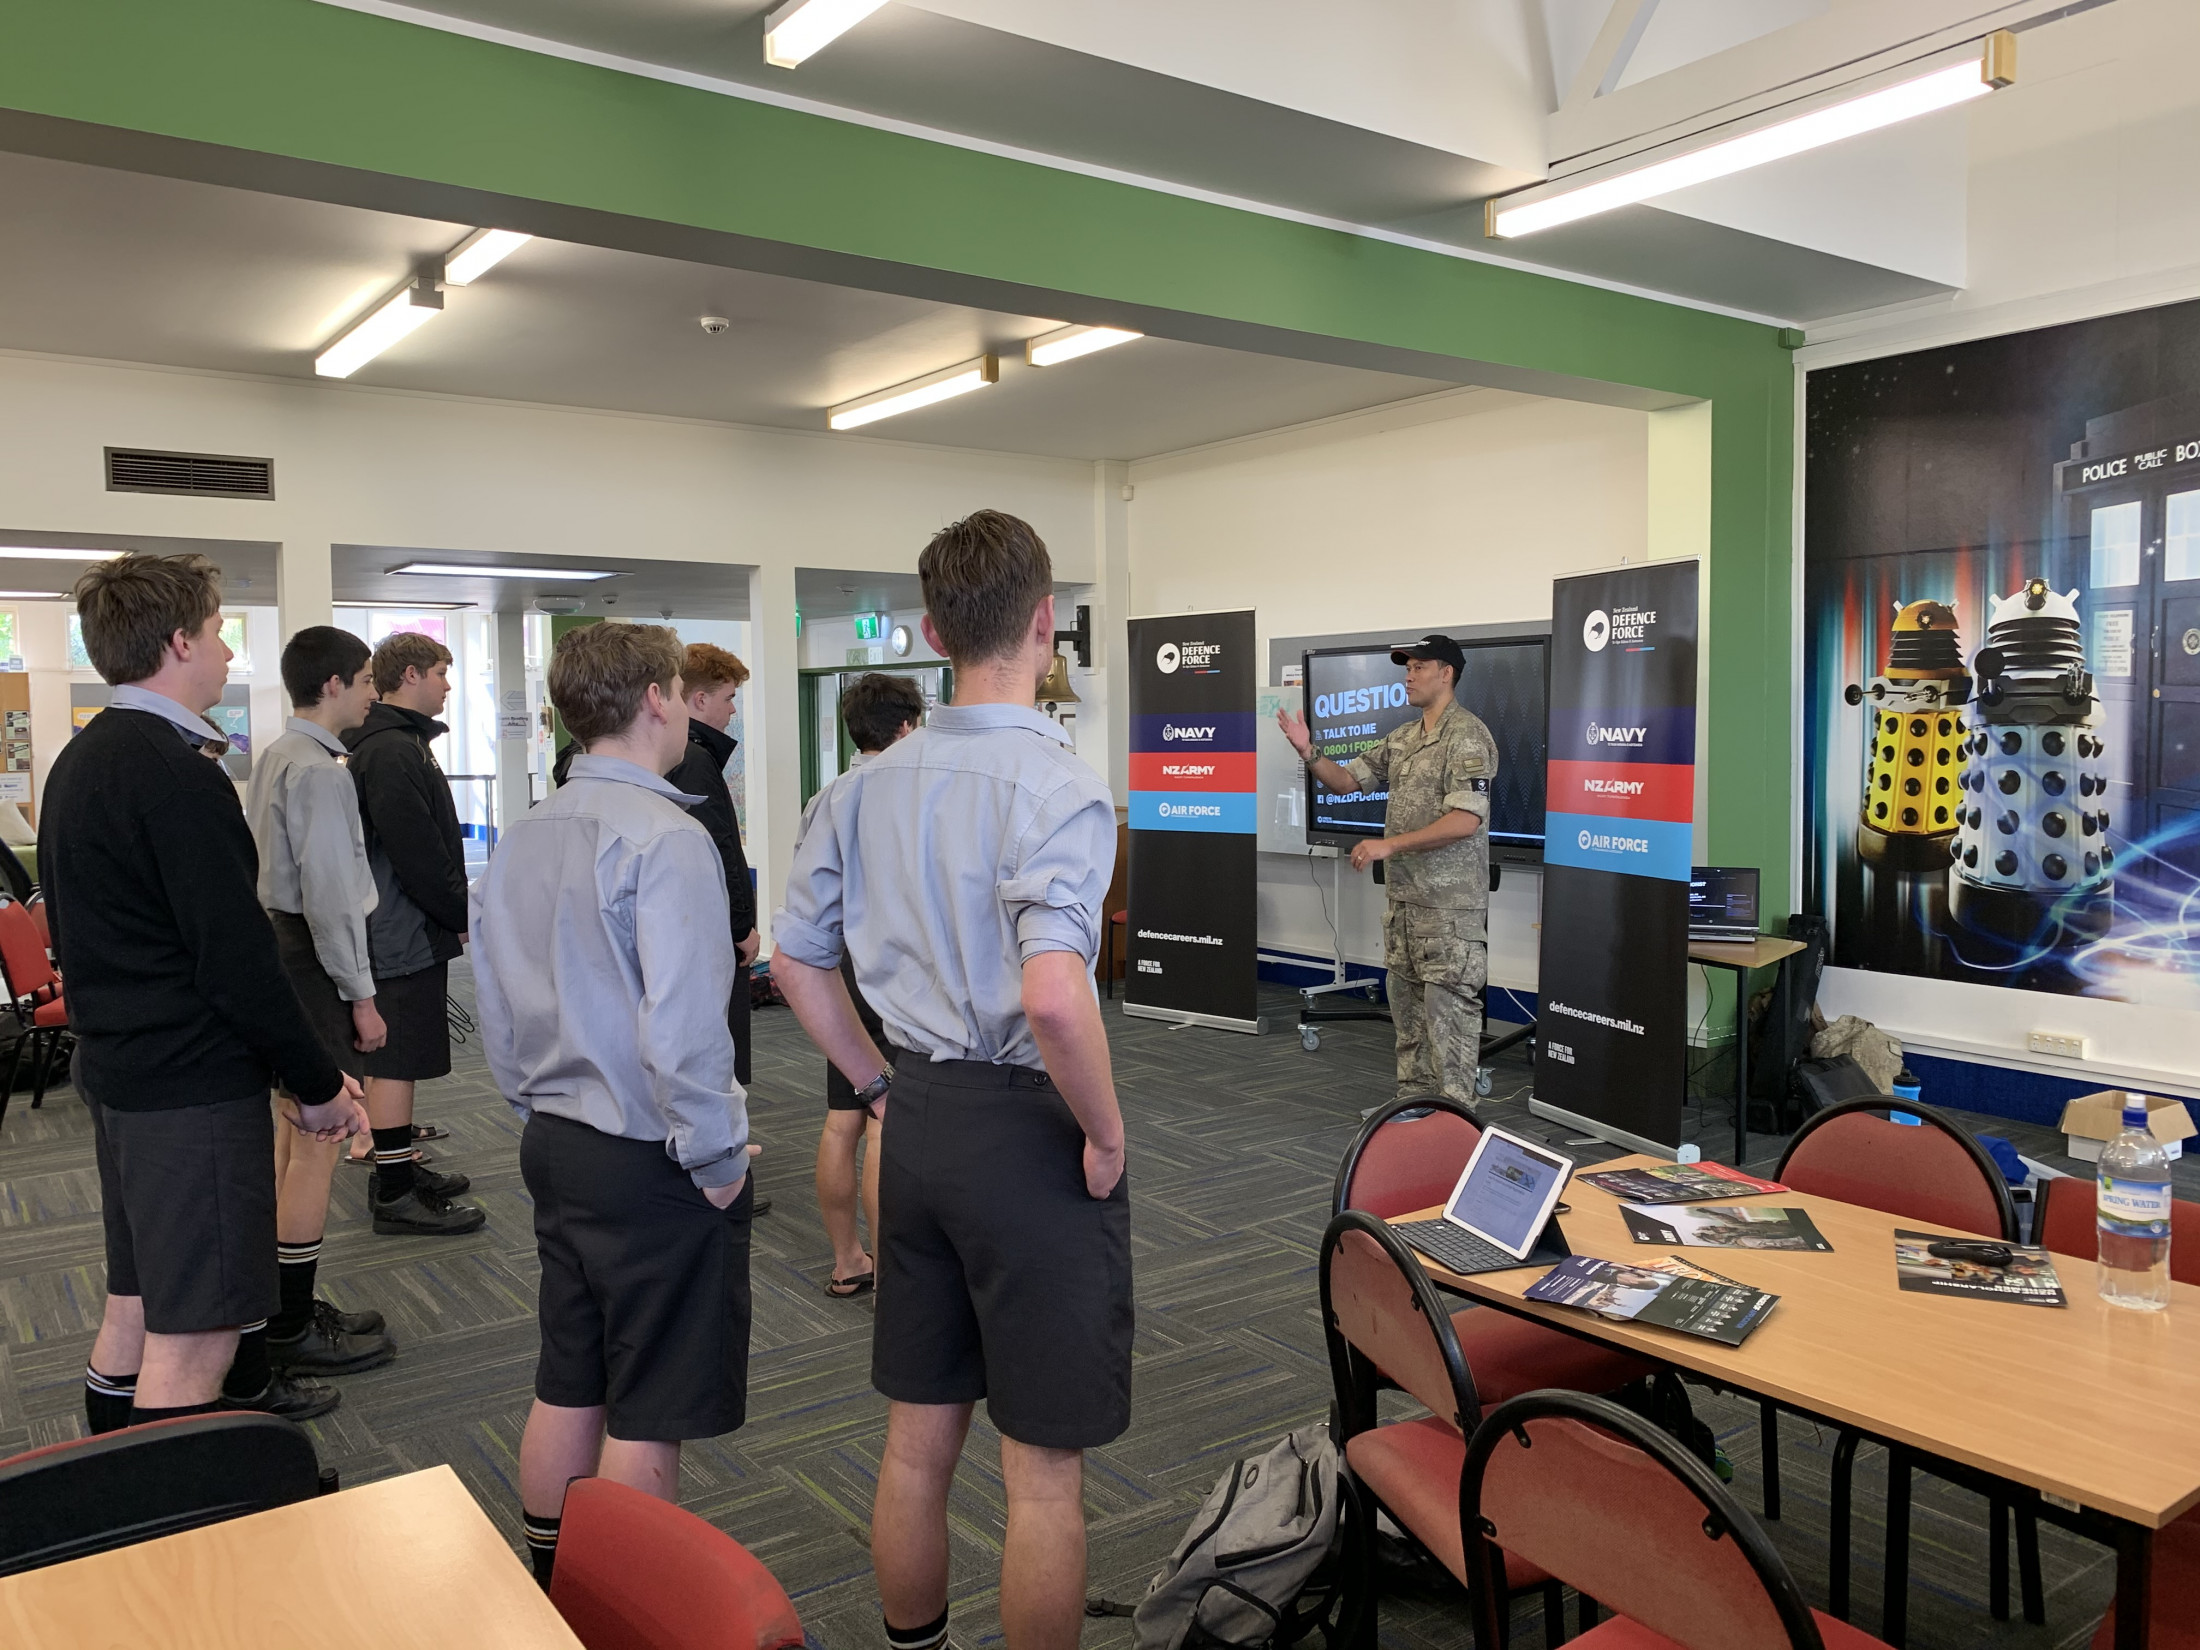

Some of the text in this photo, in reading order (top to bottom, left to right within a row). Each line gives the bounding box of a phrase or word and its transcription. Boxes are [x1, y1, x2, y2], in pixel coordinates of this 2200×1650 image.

[2134, 449, 2167, 464] PUBLIC
[2082, 459, 2127, 483] POLICE
[2138, 459, 2163, 470] CALL
[1612, 611, 1656, 627] DEFENCE
[1612, 626, 1644, 640] FORCE
[1182, 645, 1220, 656] DEFENCE
[1182, 655, 1210, 665] FORCE
[1315, 682, 1410, 718] QUESTIO
[1174, 727, 1216, 738] NAVY
[1323, 723, 1377, 740] TALK TO ME
[1600, 728, 1647, 742] NAVY
[1324, 743, 1347, 756] 0800
[1349, 742, 1353, 754] 1
[1171, 805, 1221, 817] AIR FORCE
[1592, 835, 1610, 849] AIR
[1612, 837, 1649, 853] FORCE
[1138, 929, 1223, 945] defencecareers.mil.nz
[1549, 1001, 1644, 1035] defencecareers.mil.nz
[2131, 1198, 2162, 1209] WATER
